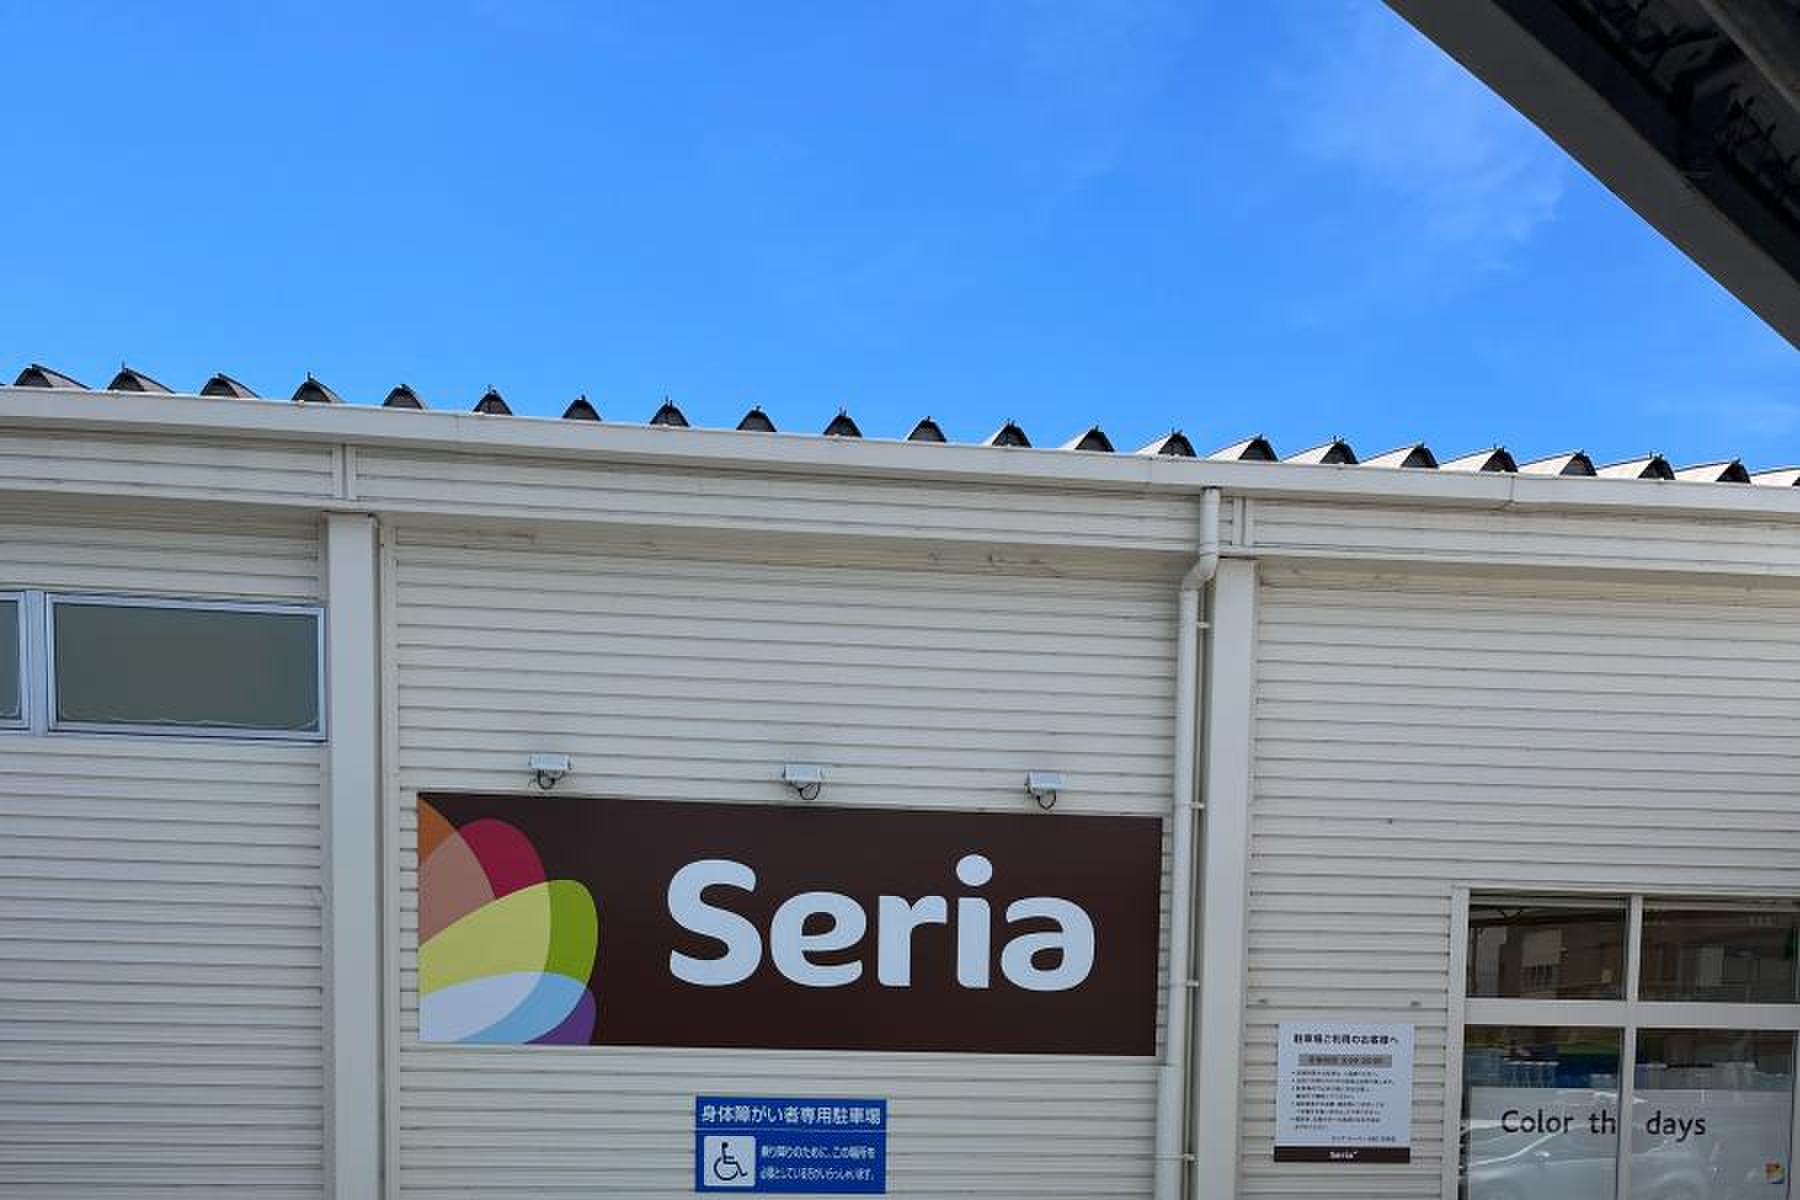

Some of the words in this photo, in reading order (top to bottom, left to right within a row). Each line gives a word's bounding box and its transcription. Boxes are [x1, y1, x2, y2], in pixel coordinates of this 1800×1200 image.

[668, 855, 1095, 991] Seria
[702, 1105, 882, 1125] 身体障がい者専用駐車場
[1502, 1109, 1575, 1134] Color
[1588, 1110, 1617, 1135] th
[1646, 1110, 1706, 1143] days
